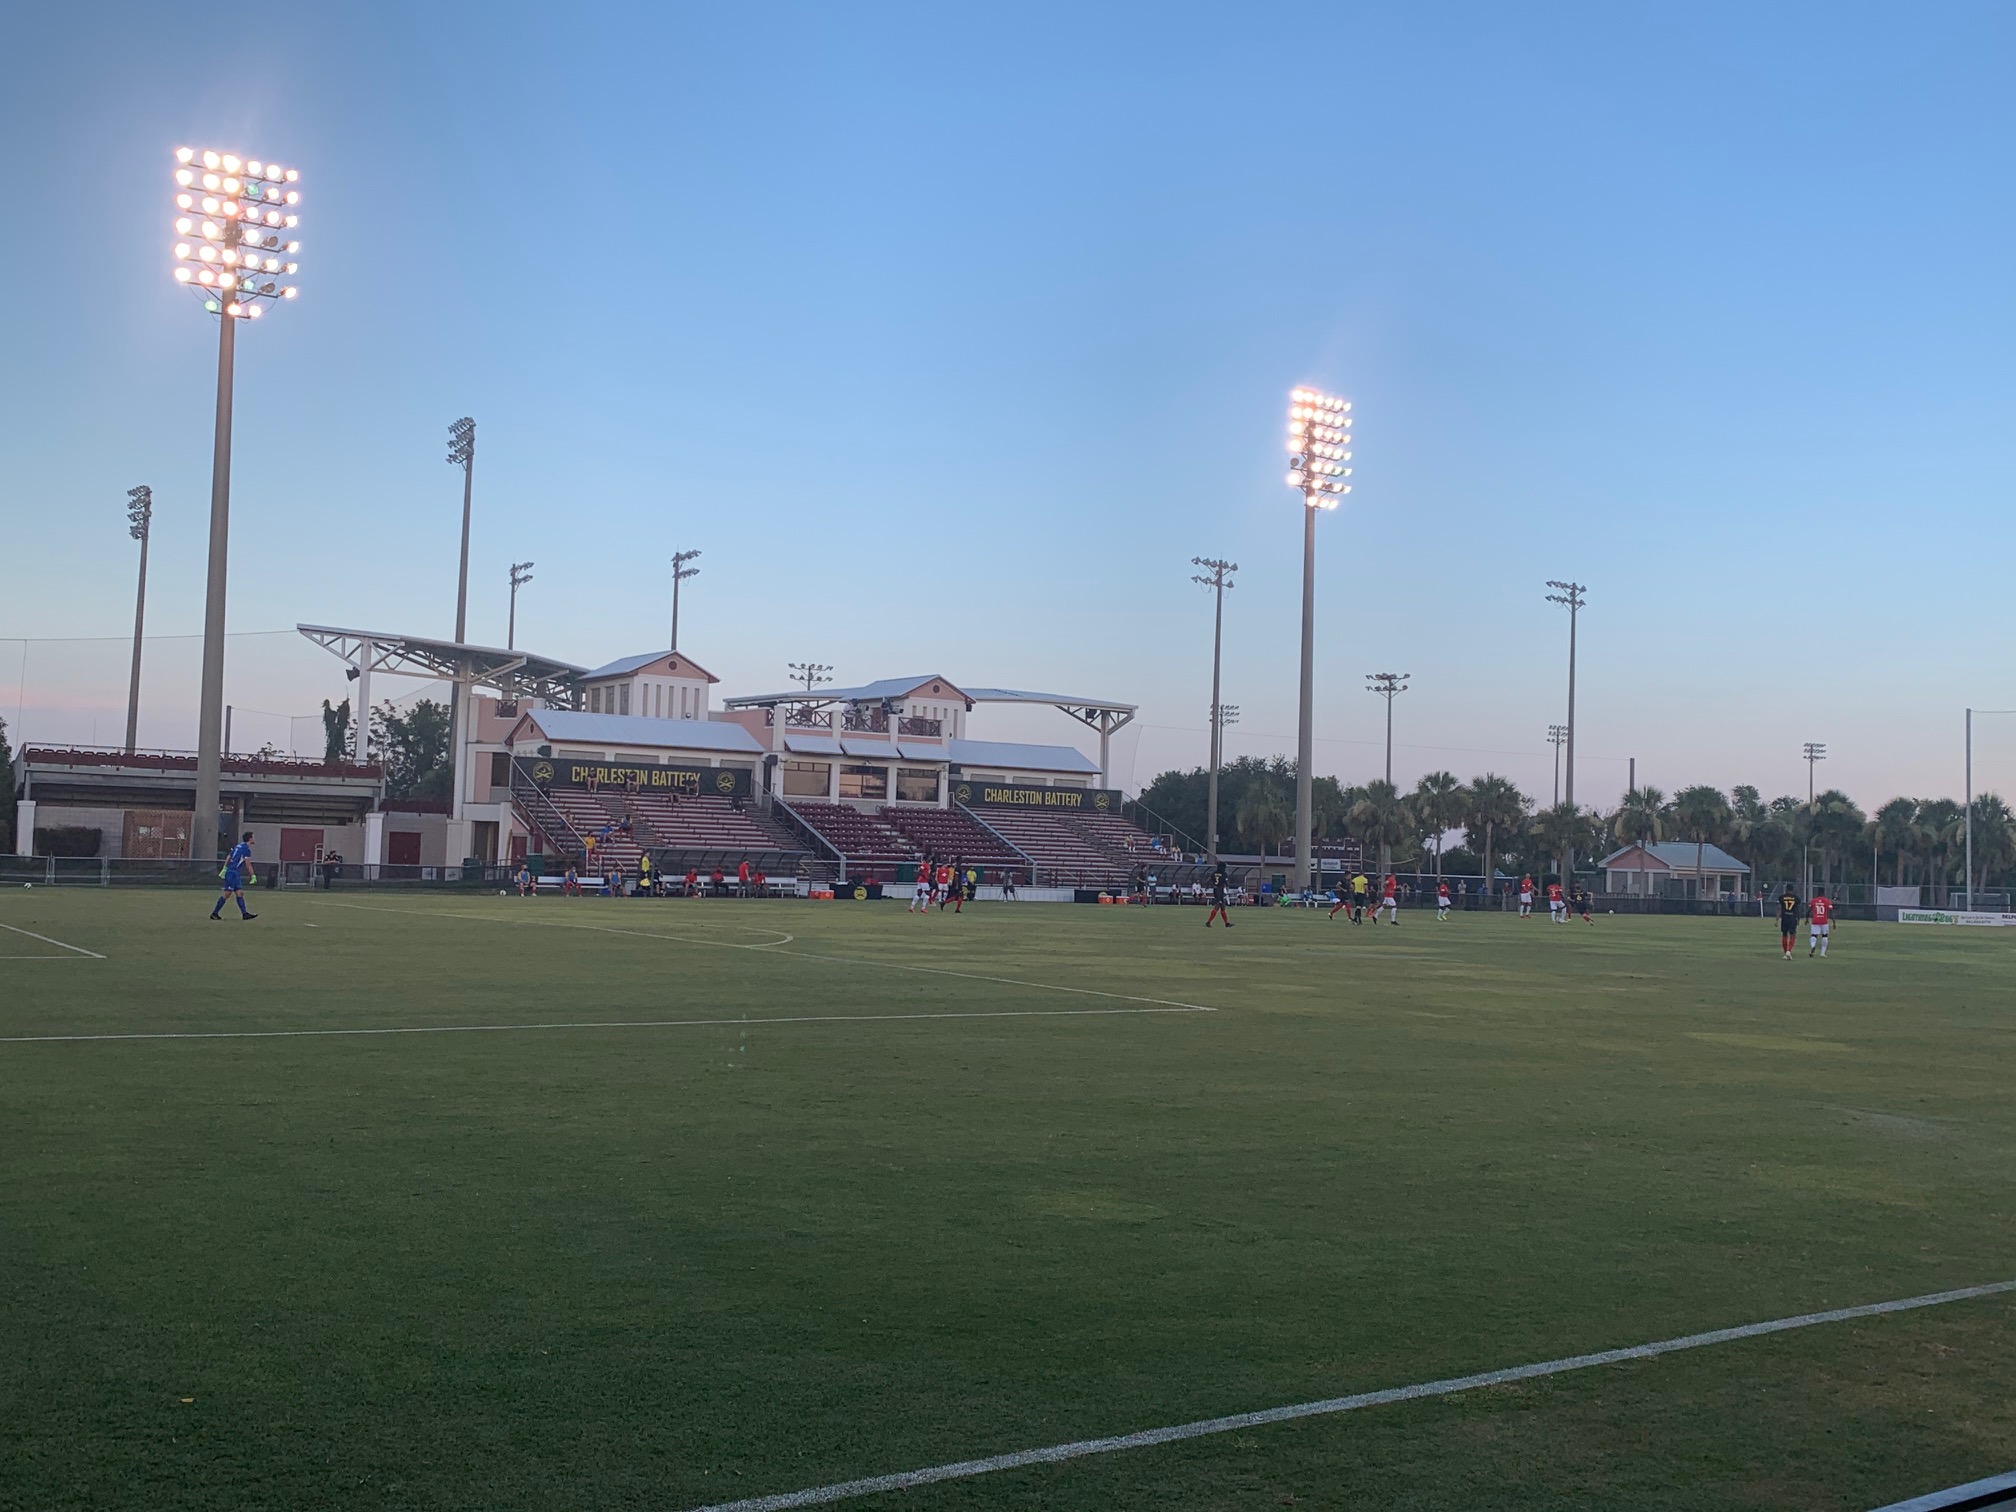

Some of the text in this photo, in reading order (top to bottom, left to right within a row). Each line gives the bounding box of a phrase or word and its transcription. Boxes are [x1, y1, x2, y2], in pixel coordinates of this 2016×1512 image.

[571, 766, 648, 785] CHRLESTON
[984, 788, 1082, 807] CHARLESTON BATTERY
[1784, 901, 1796, 911] 17
[1815, 905, 1825, 915] 10
